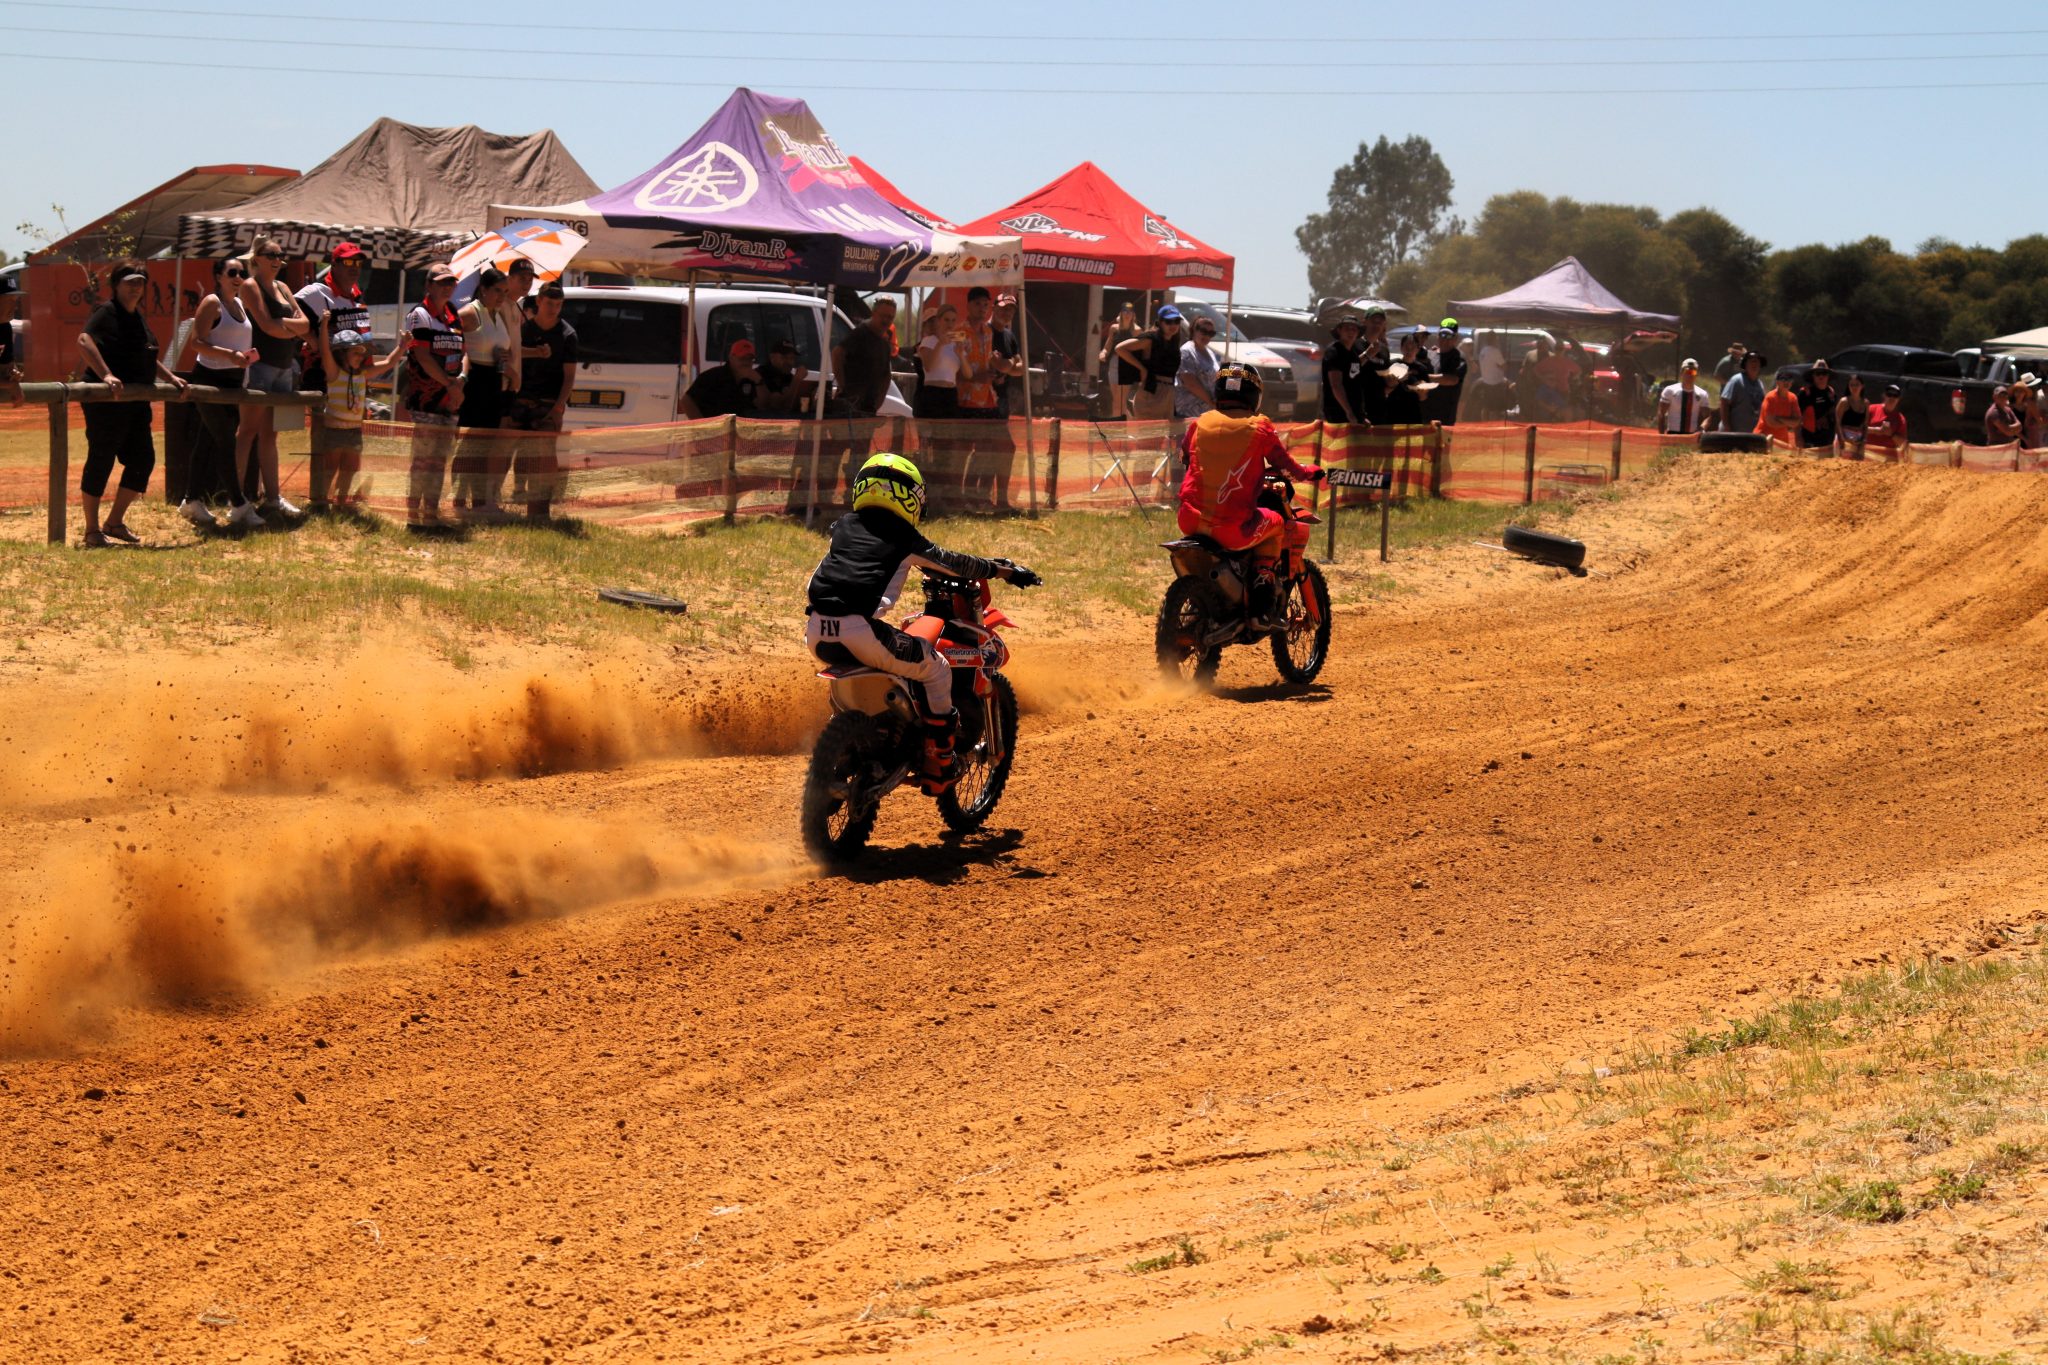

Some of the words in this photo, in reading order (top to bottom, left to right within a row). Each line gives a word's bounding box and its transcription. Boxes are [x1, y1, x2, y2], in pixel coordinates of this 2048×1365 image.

[699, 230, 787, 258] DJvanR
[843, 246, 880, 261] BUILDING
[1058, 256, 1114, 275] GRINDING
[1337, 471, 1384, 487] FINISH
[820, 619, 840, 637] FLY
